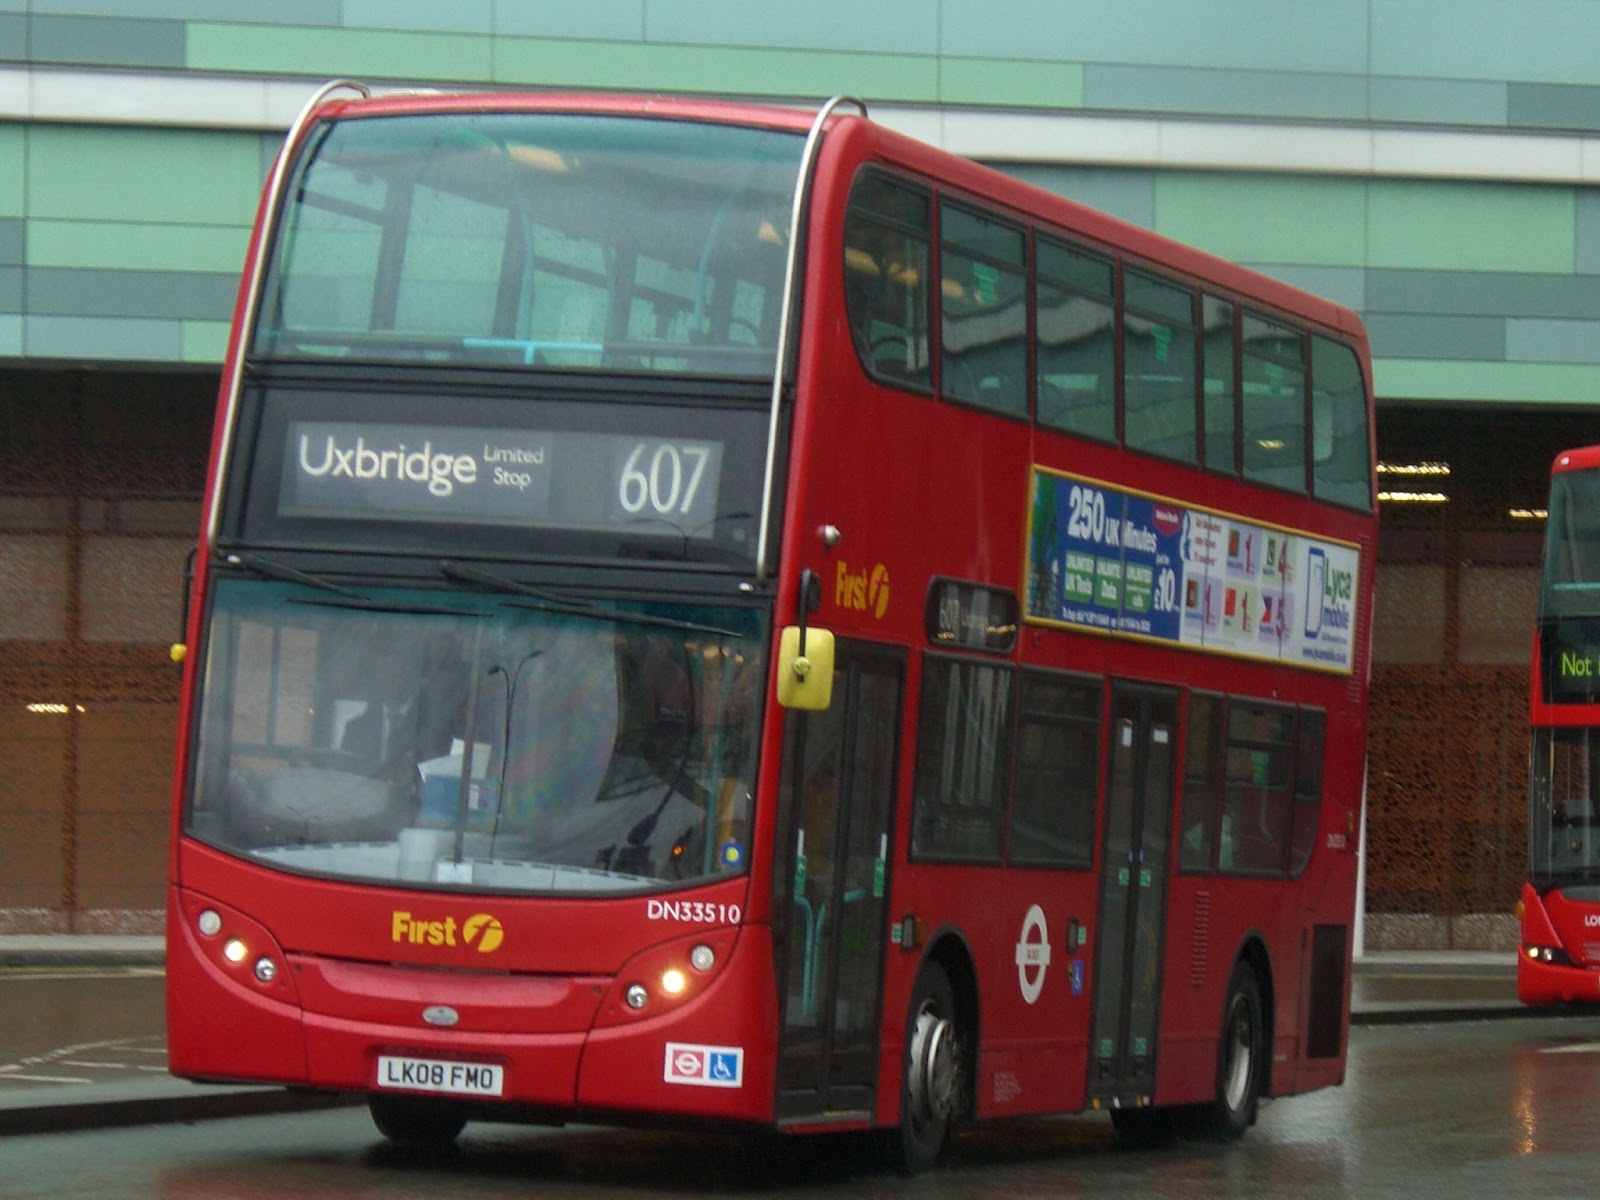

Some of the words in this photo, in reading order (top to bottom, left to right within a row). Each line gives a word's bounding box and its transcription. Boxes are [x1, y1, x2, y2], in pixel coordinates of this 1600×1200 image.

[483, 445, 543, 465] Limited
[299, 434, 477, 497] Uxbridge
[618, 443, 711, 514] 607
[493, 467, 531, 490] Stop
[1067, 485, 1105, 543] 250
[835, 559, 868, 611] First
[1325, 556, 1351, 606] Lyca
[1562, 652, 1592, 676] Not
[647, 899, 741, 925] DN33510
[1584, 914, 1600, 927] LO
[392, 910, 456, 947] First
[387, 1059, 443, 1085] LK08
[449, 1065, 494, 1090] FMO
